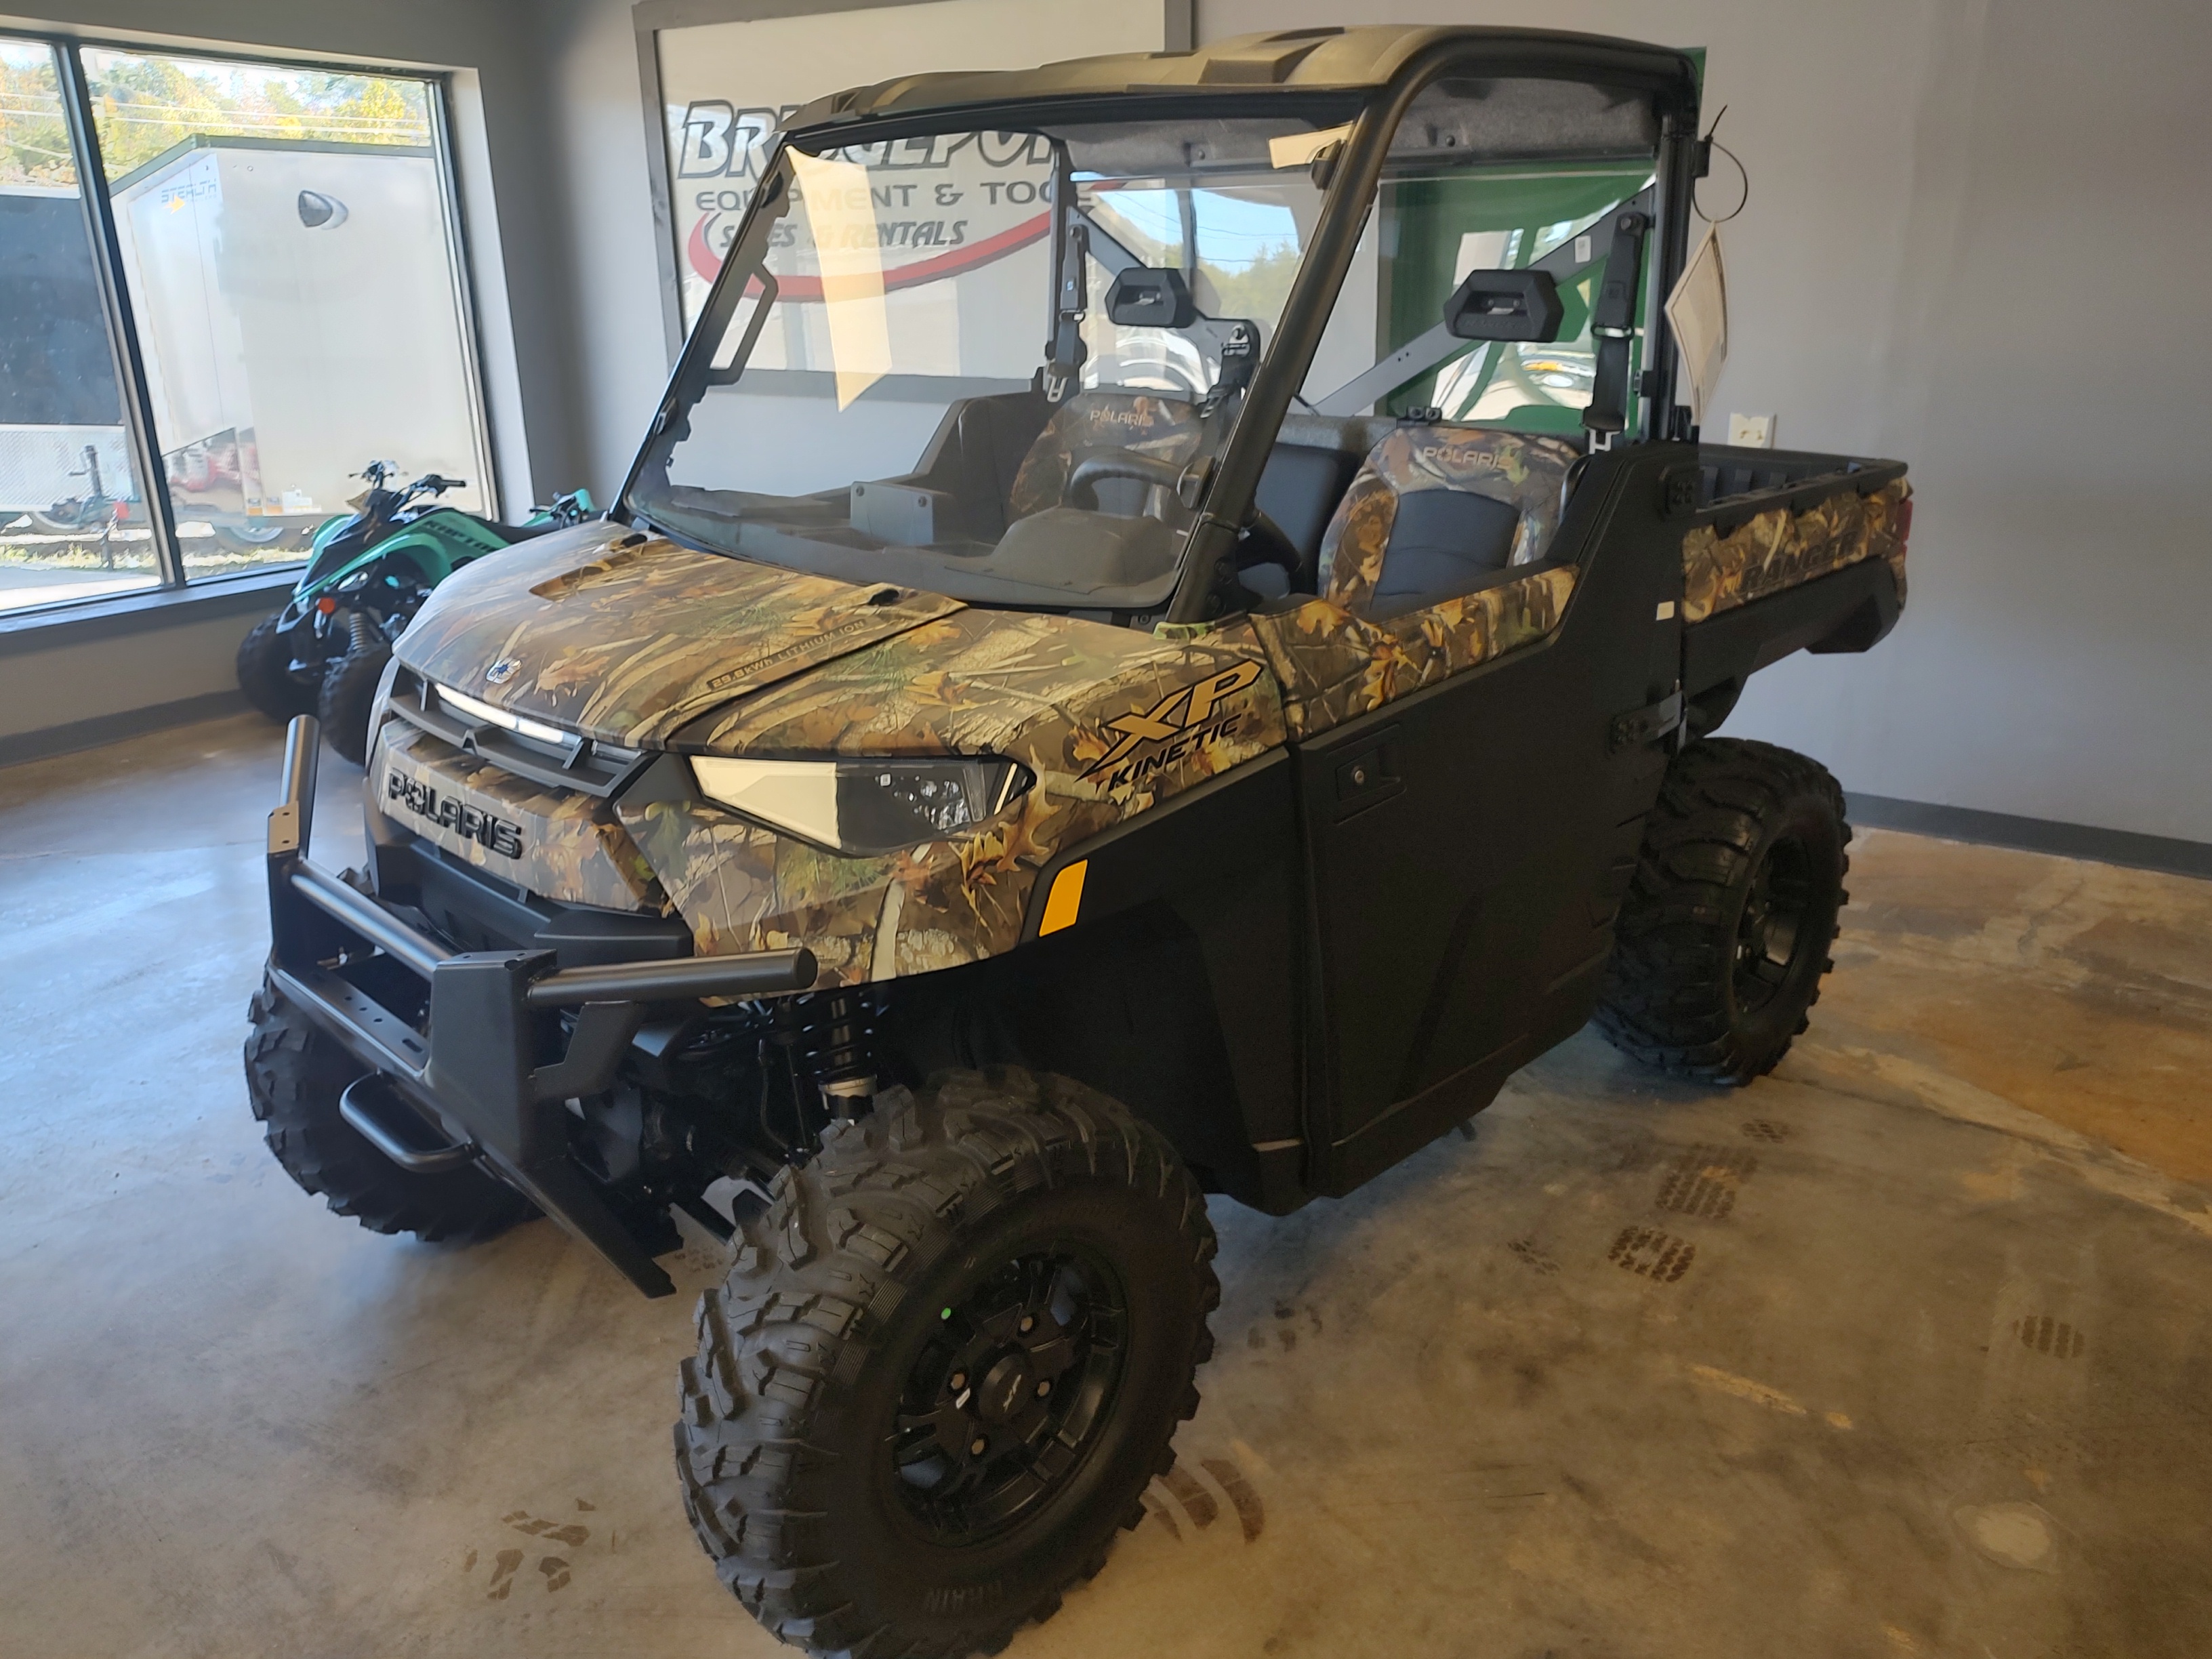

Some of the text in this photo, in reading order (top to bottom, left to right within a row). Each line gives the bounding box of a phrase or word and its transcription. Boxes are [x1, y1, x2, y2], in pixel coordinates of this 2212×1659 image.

[935, 183, 964, 207] &
[842, 220, 968, 249] RENTALS
[1423, 446, 1513, 470] POLARIS
[1740, 530, 1859, 593] RANGER
[778, 632, 836, 660] LITHIUM
[838, 620, 865, 636] ION
[1074, 658, 1265, 783] XP
[1108, 713, 1242, 792] KINETIC
[388, 767, 523, 860] POLARIS
